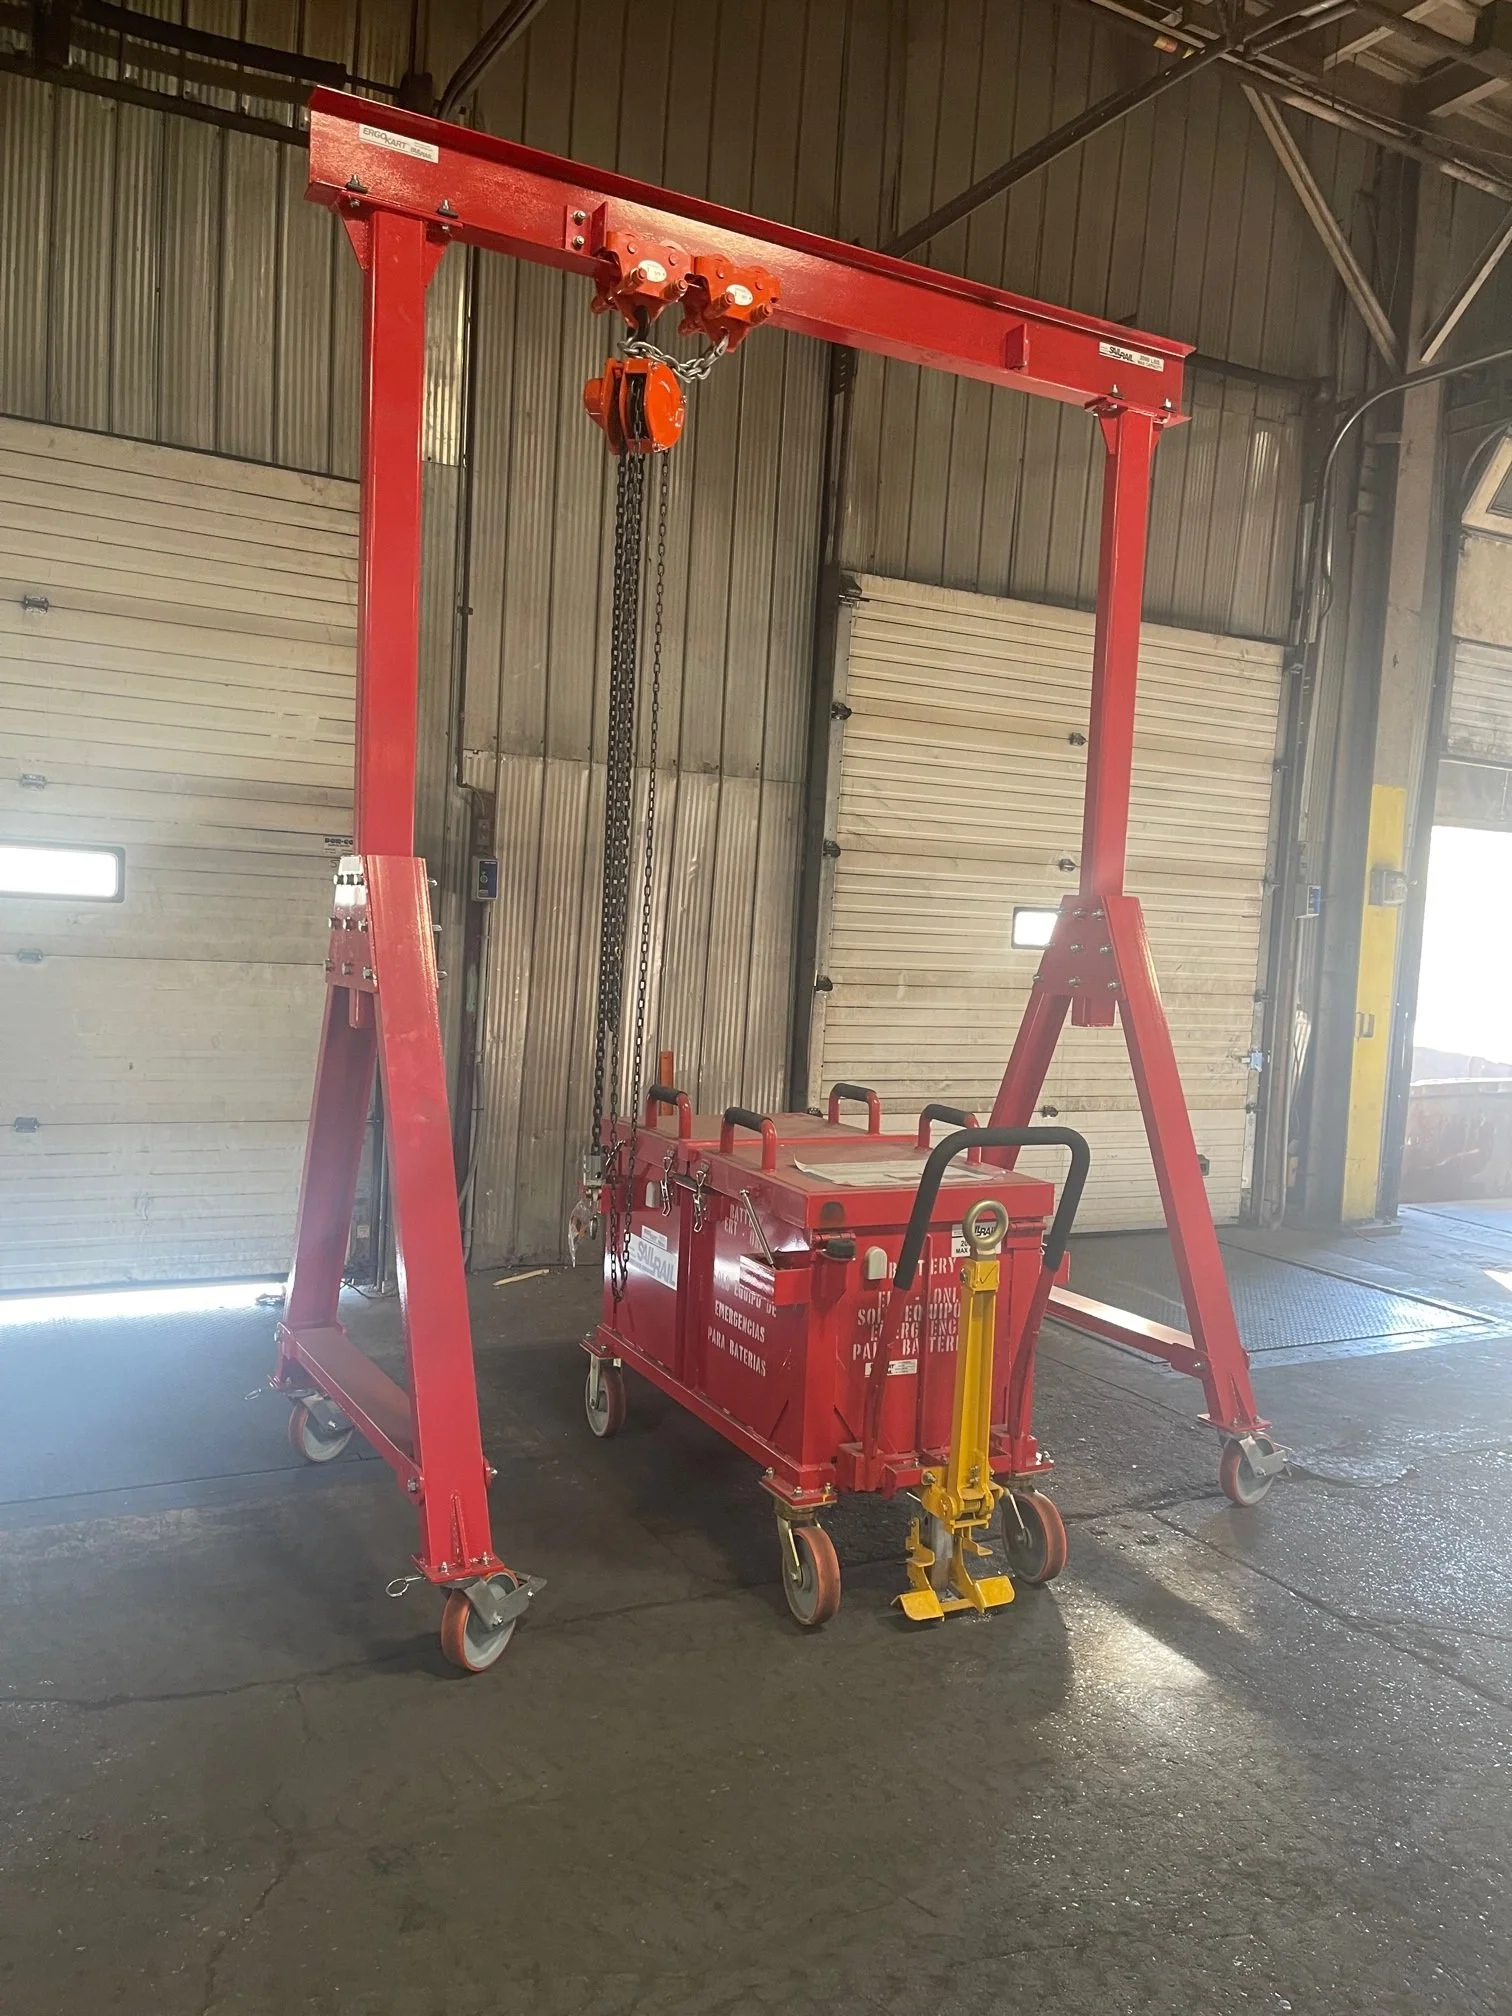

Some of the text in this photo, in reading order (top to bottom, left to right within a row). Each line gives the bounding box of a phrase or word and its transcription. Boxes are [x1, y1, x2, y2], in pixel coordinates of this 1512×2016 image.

[714, 1299, 765, 1344] EMERGENCIAS
[708, 1325, 766, 1376] PARA BATERIAS
